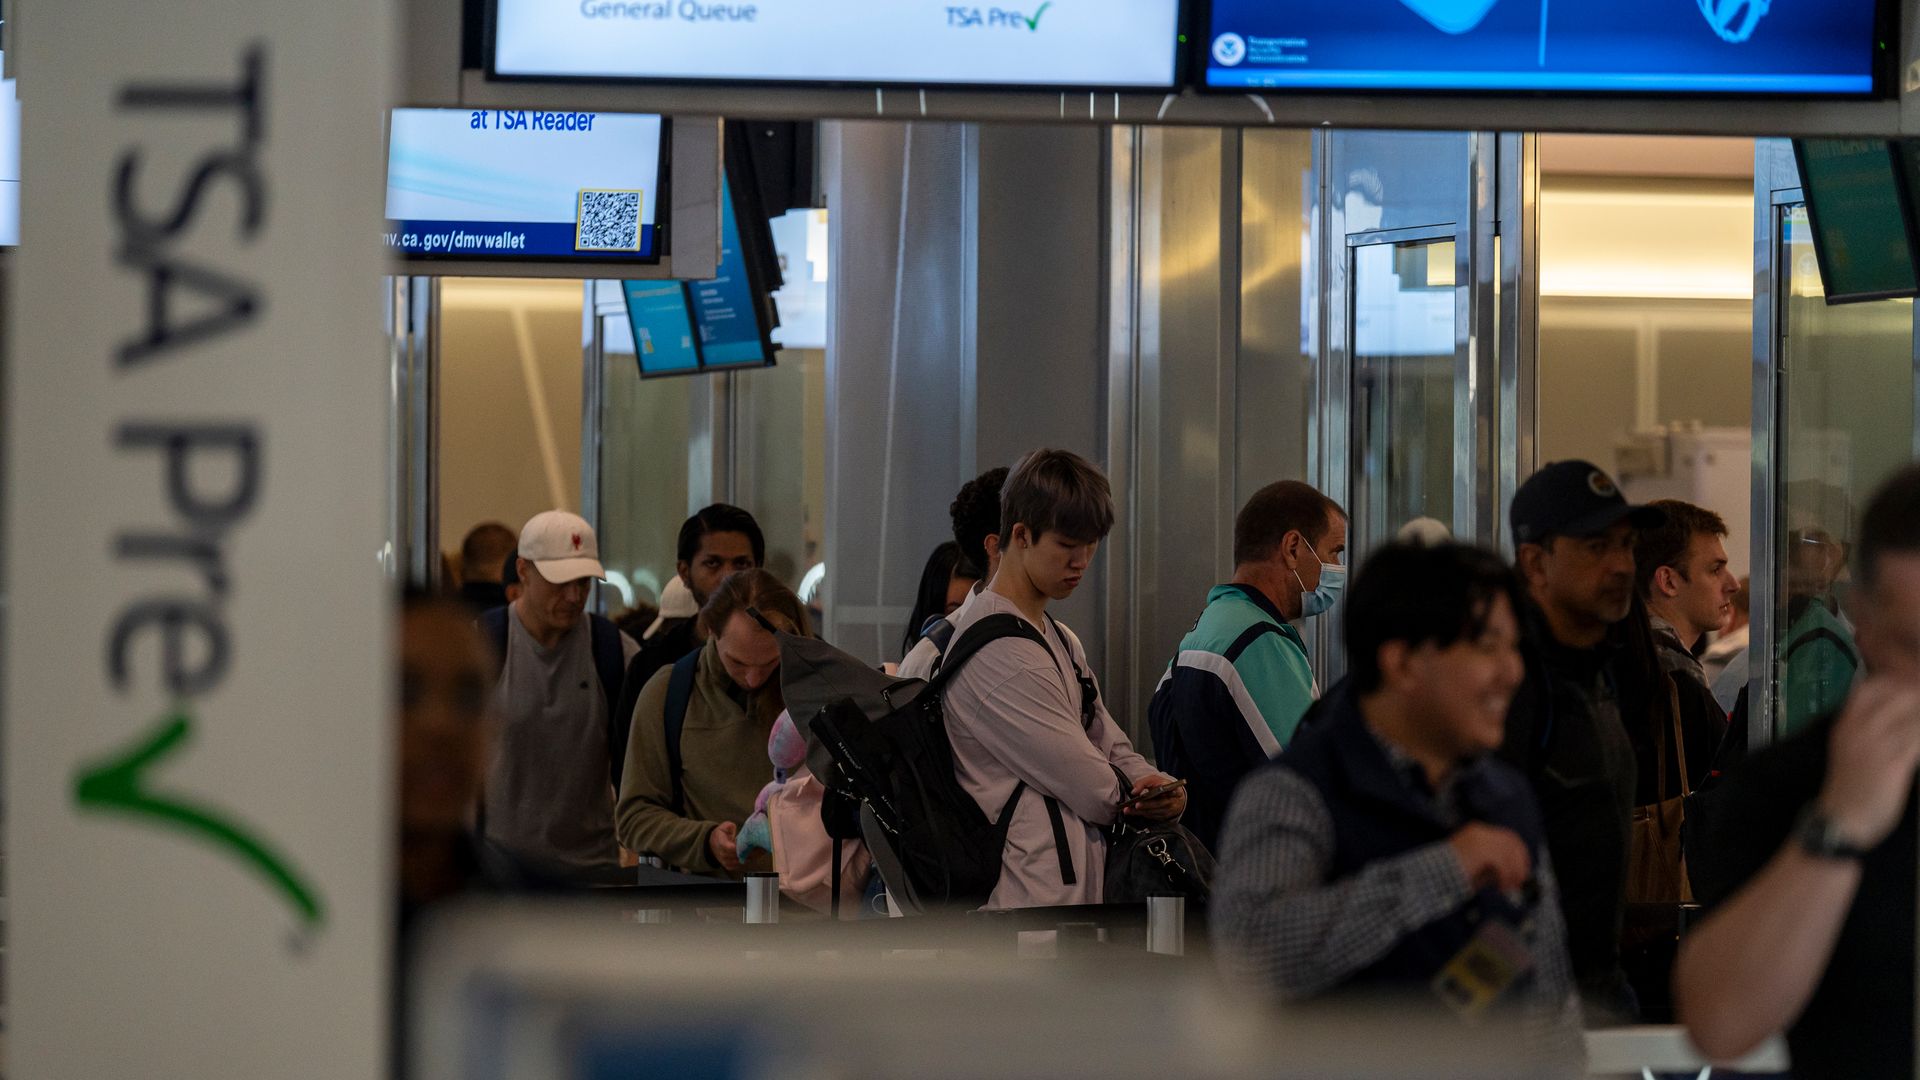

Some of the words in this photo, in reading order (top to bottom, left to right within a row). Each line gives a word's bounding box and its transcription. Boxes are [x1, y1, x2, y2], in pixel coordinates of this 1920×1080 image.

[580, 0, 672, 20] General
[678, 0, 758, 23] Queue
[944, 6, 984, 28] TSA
[988, 7, 1023, 29] Pre
[470, 109, 488, 130] at
[532, 111, 596, 132] Reader
[111, 40, 269, 370] TSA
[107, 421, 262, 698] Pre
